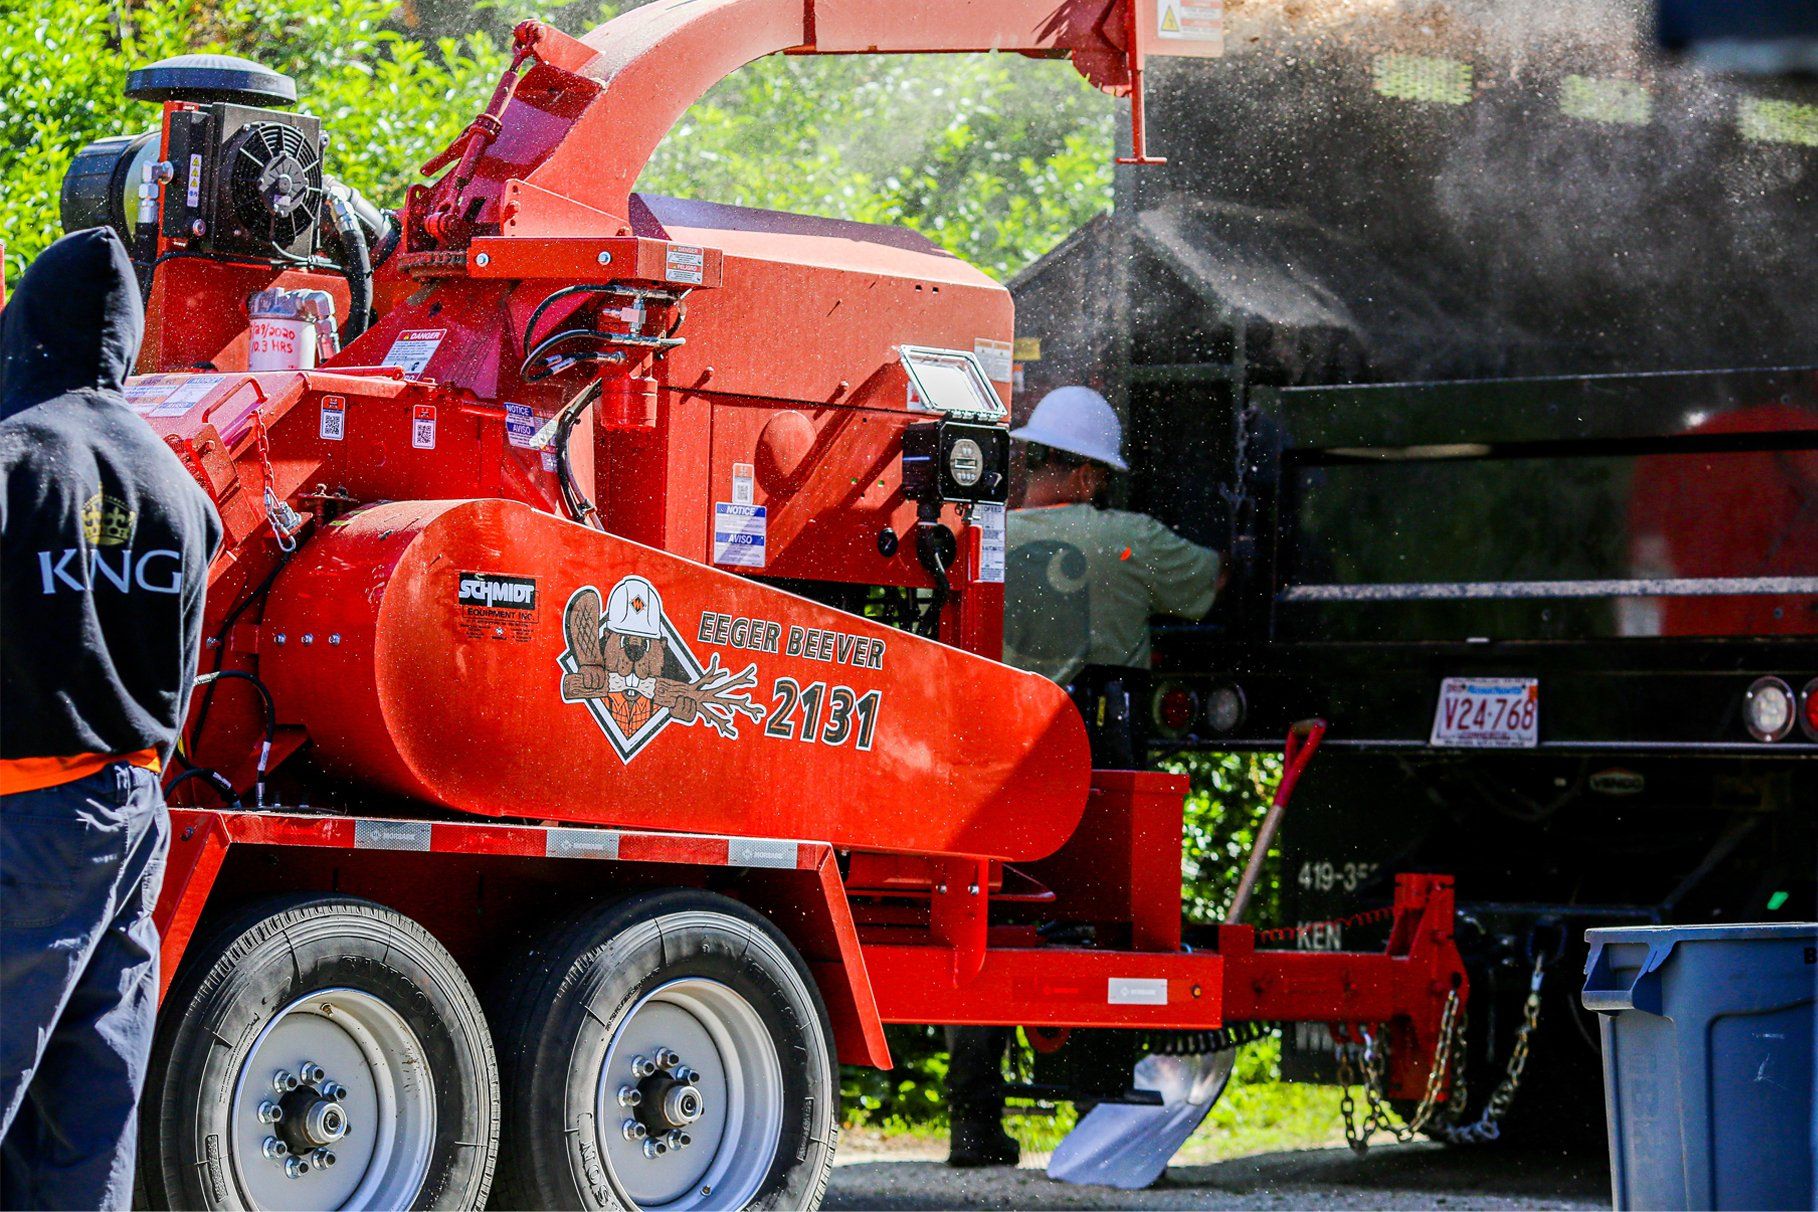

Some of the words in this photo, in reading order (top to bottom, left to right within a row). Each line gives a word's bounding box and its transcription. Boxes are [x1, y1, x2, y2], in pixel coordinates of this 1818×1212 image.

[410, 332, 441, 340] DANGER
[271, 340, 293, 354] HRS
[506, 404, 530, 416] NOTICE
[512, 424, 531, 434] AVISO
[726, 505, 756, 516] NOTICE
[728, 534, 753, 544] AVISO
[458, 579, 535, 607] SCHMIDT
[467, 607, 516, 619] EQUIPMENT
[697, 611, 779, 653] EEGER
[786, 624, 887, 670] BEEVER
[764, 676, 883, 751] 2131
[1297, 921, 1342, 950] KEN
